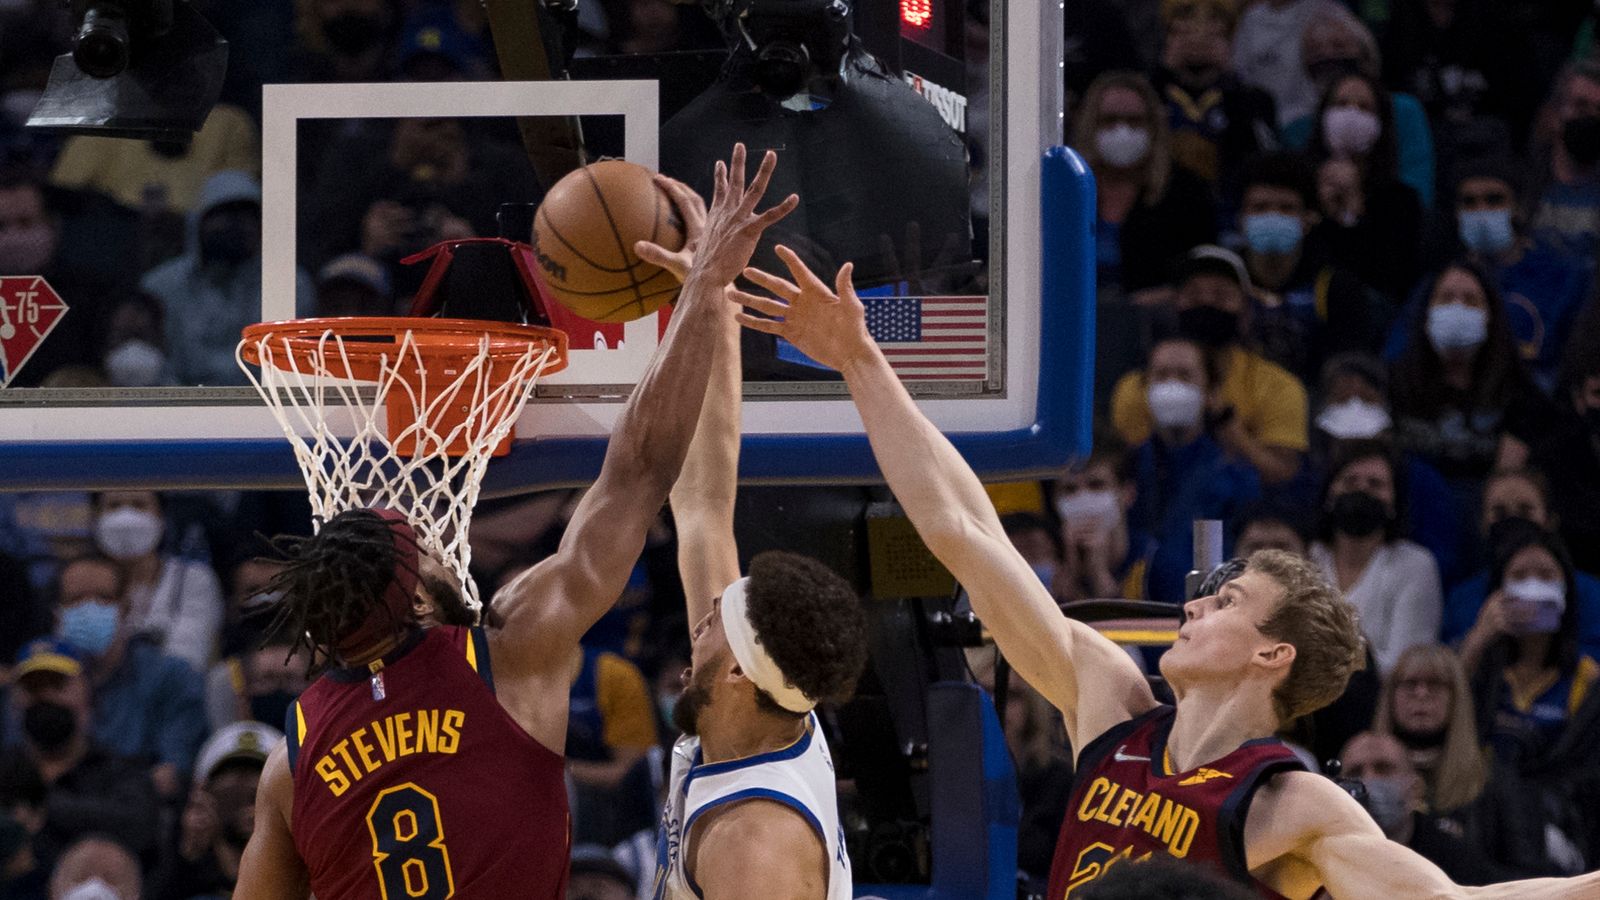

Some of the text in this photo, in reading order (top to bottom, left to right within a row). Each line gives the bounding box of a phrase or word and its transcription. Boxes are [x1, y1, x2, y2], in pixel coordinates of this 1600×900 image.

[922, 79, 968, 133] TISSOT
[15, 291, 40, 324] 75
[314, 709, 465, 797] STEVENS
[366, 782, 455, 900] 8
